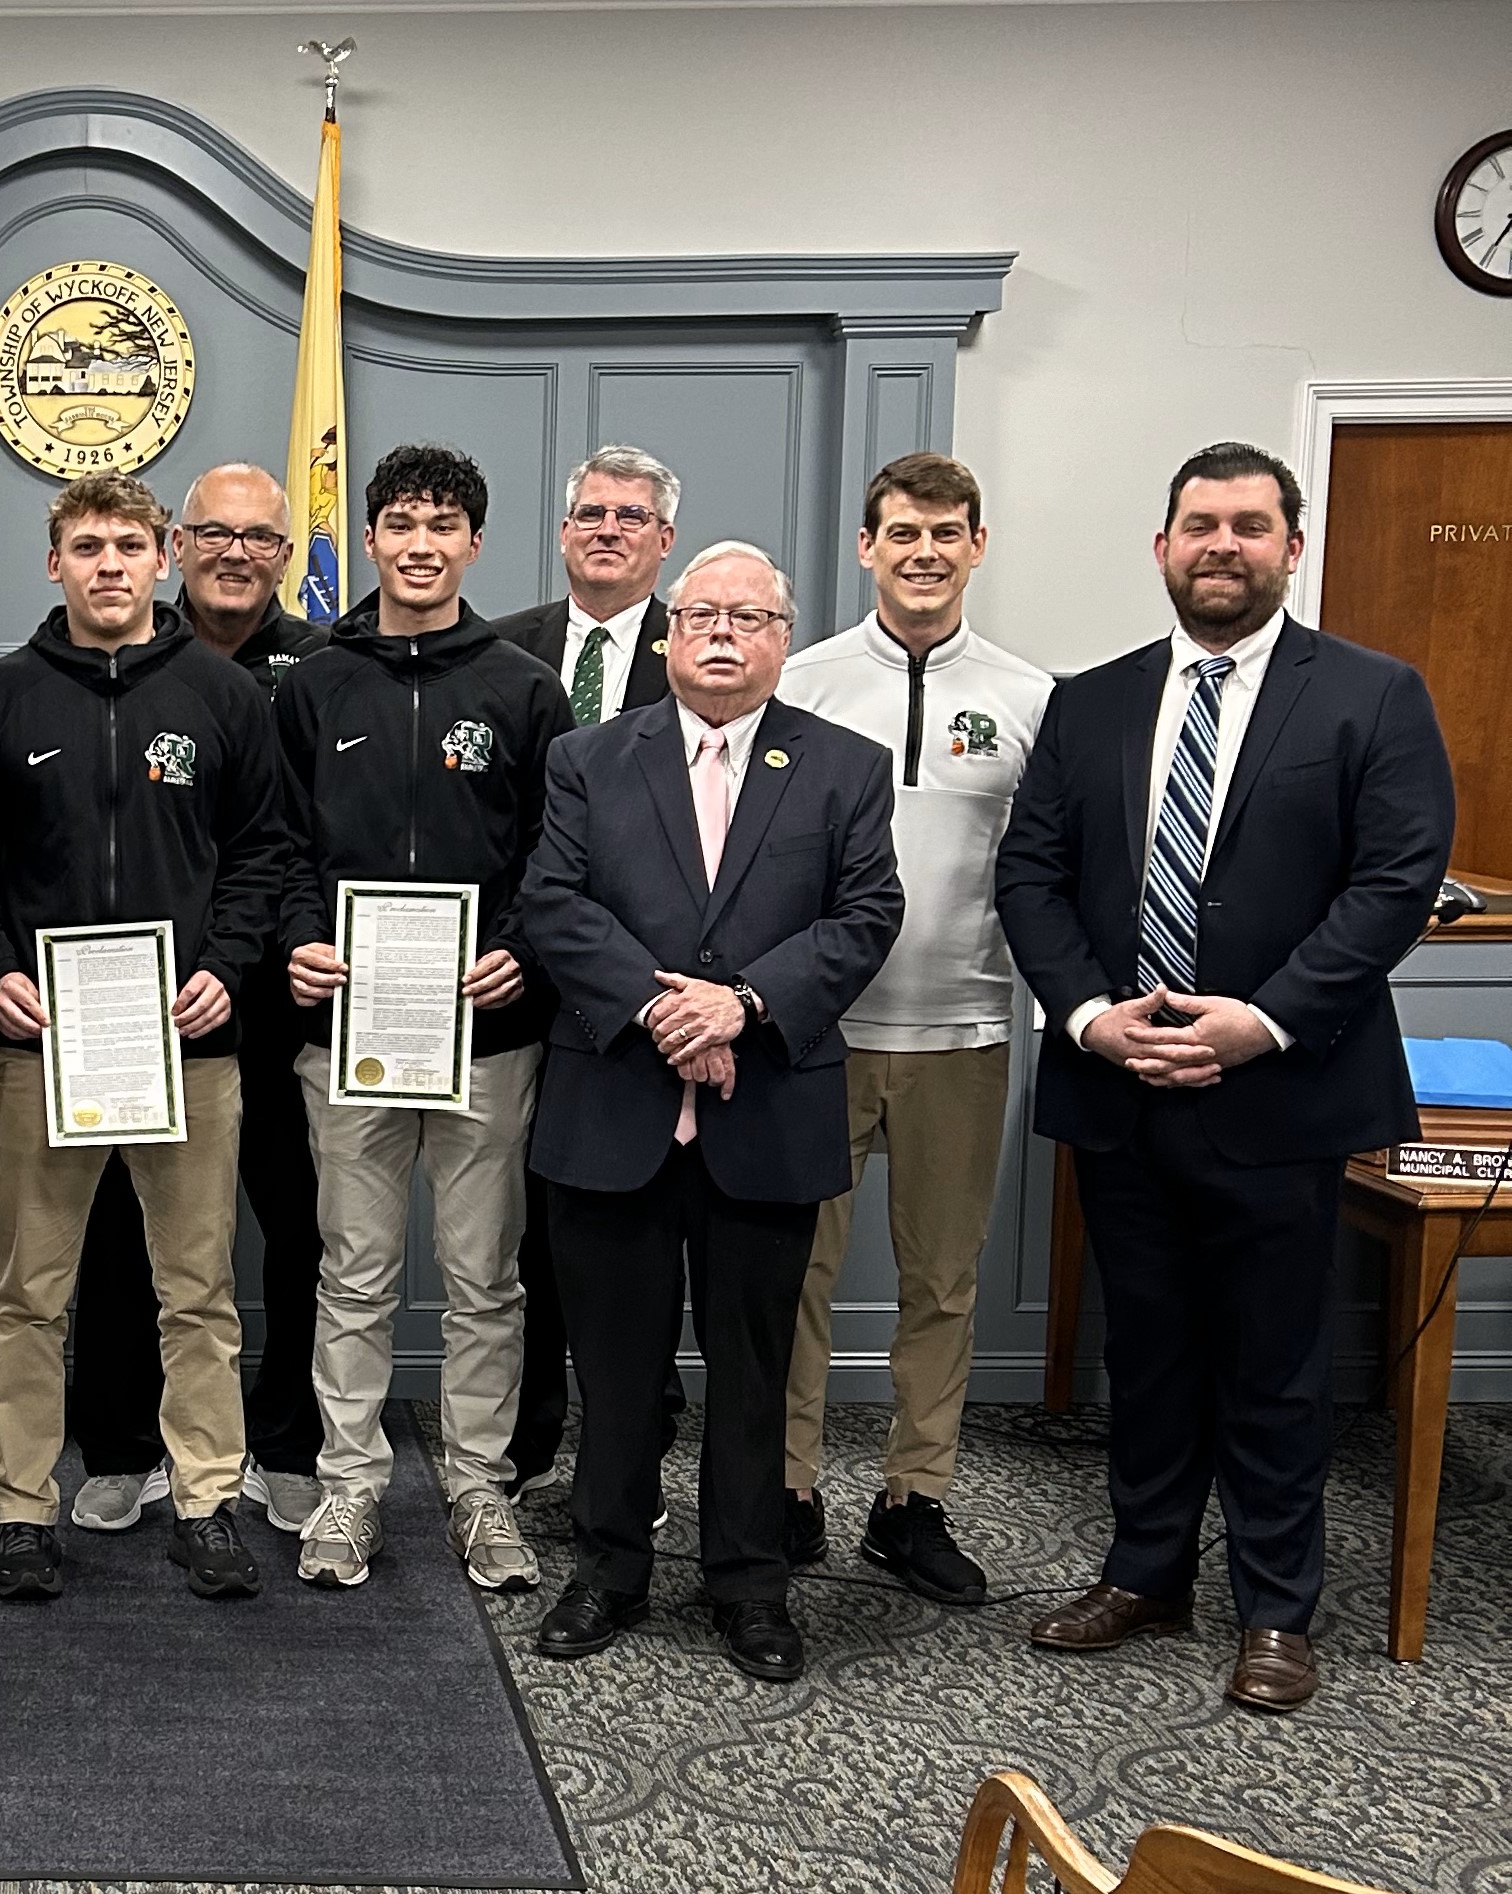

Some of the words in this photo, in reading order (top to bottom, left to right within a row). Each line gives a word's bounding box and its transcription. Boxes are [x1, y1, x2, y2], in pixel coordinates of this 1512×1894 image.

[21, 297, 42, 324] OF
[45, 279, 140, 312] WYCKOFF,
[140, 305, 174, 347] NEW
[0, 323, 28, 429] TOWNSHIP
[151, 355, 178, 429] JERSEY
[64, 448, 114, 465] 1926
[1399, 1149, 1446, 1163] NANCY
[1452, 1152, 1467, 1165] A.
[1399, 1162, 1470, 1177] MUNICIPAL
